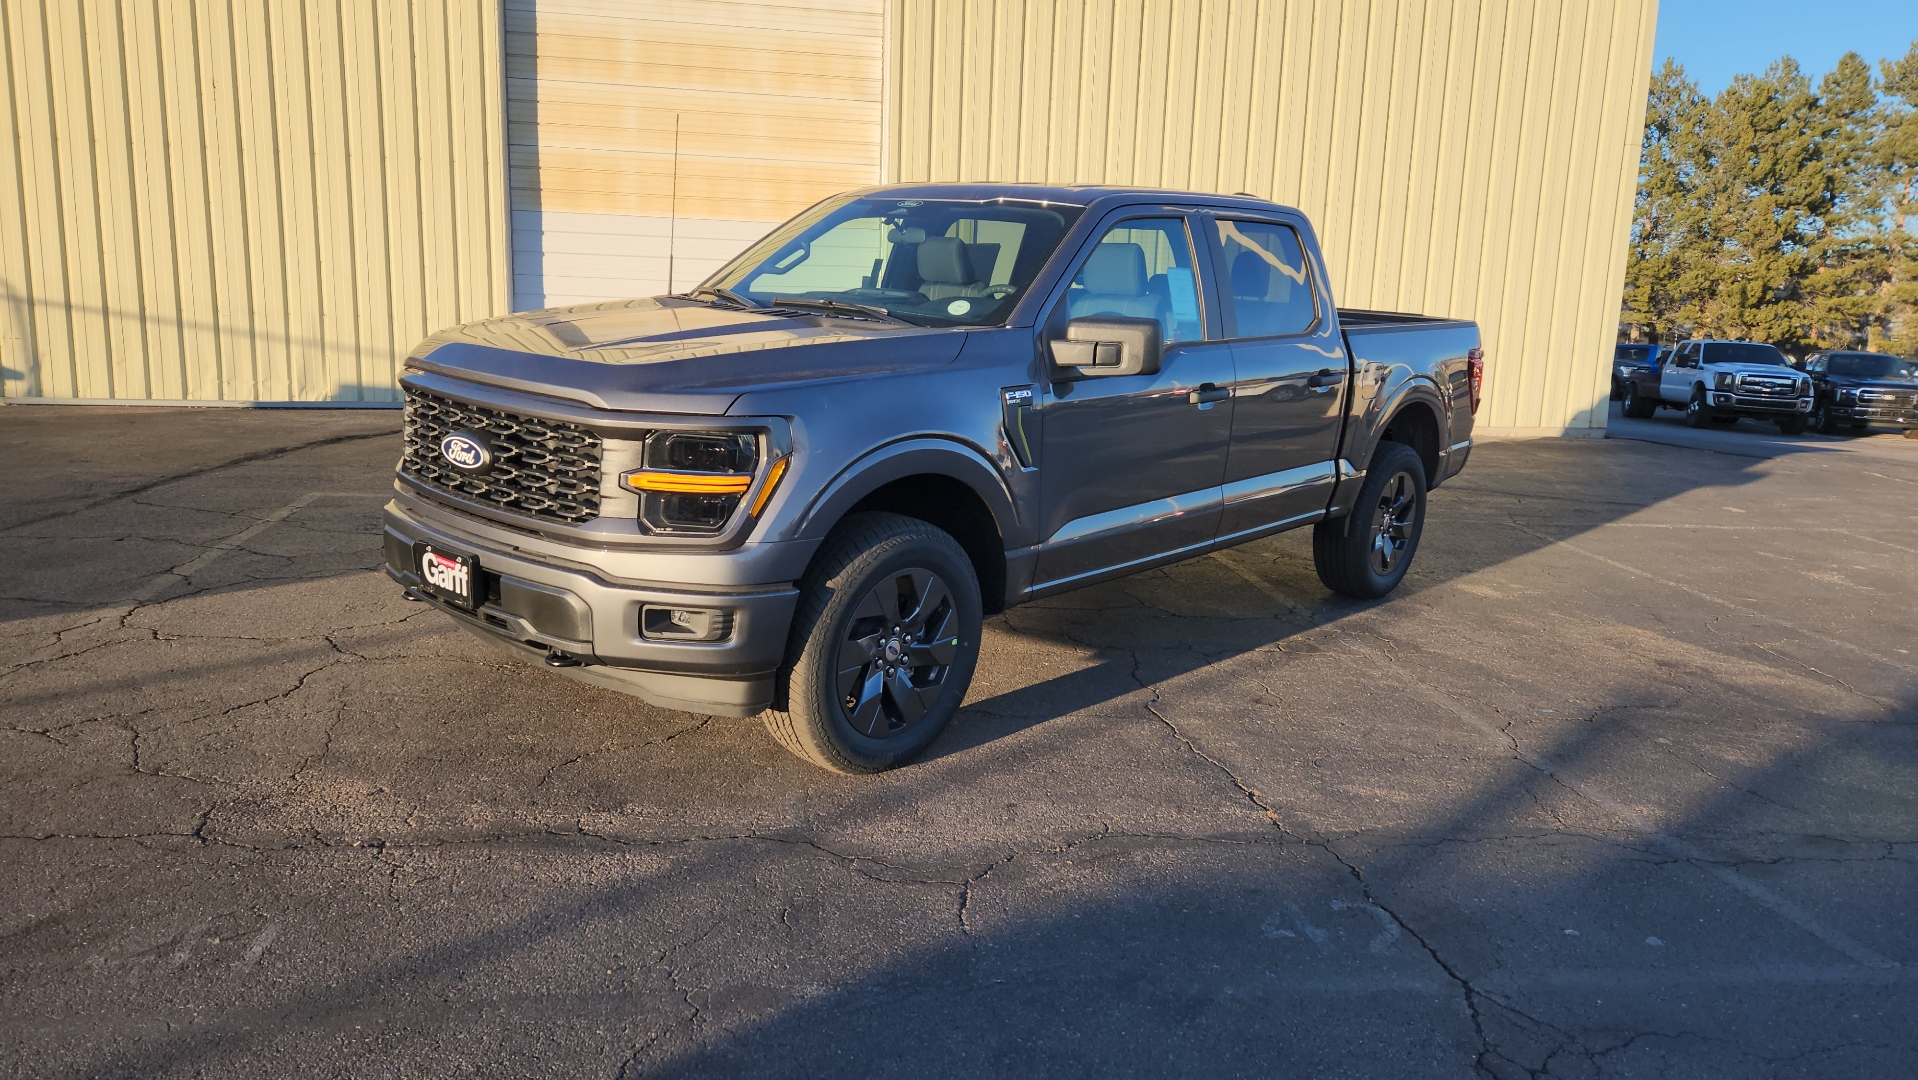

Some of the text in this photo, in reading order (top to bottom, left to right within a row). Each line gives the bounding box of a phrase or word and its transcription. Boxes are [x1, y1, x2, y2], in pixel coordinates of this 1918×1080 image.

[1005, 390, 1032, 400] F-150
[449, 440, 476, 465] Ford
[422, 552, 468, 597] Garff
